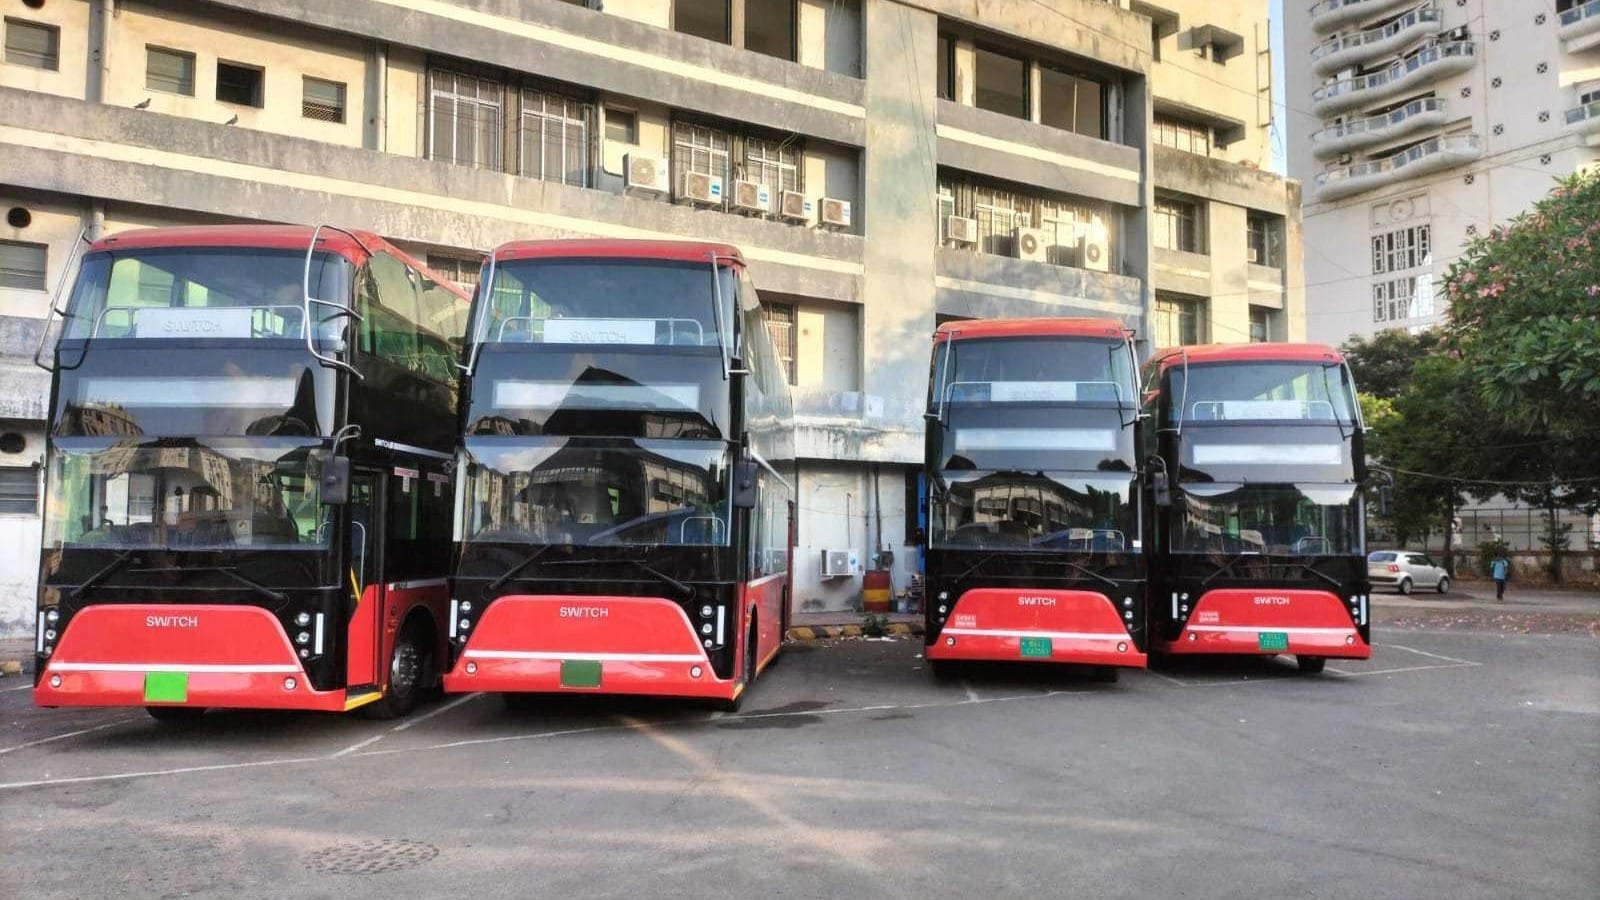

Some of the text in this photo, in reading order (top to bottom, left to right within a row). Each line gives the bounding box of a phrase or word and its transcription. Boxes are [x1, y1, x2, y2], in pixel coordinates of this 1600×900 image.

[1018, 596, 1056, 607] SWITCH
[560, 606, 609, 618] SWITCH
[146, 615, 198, 628] SWITCH
